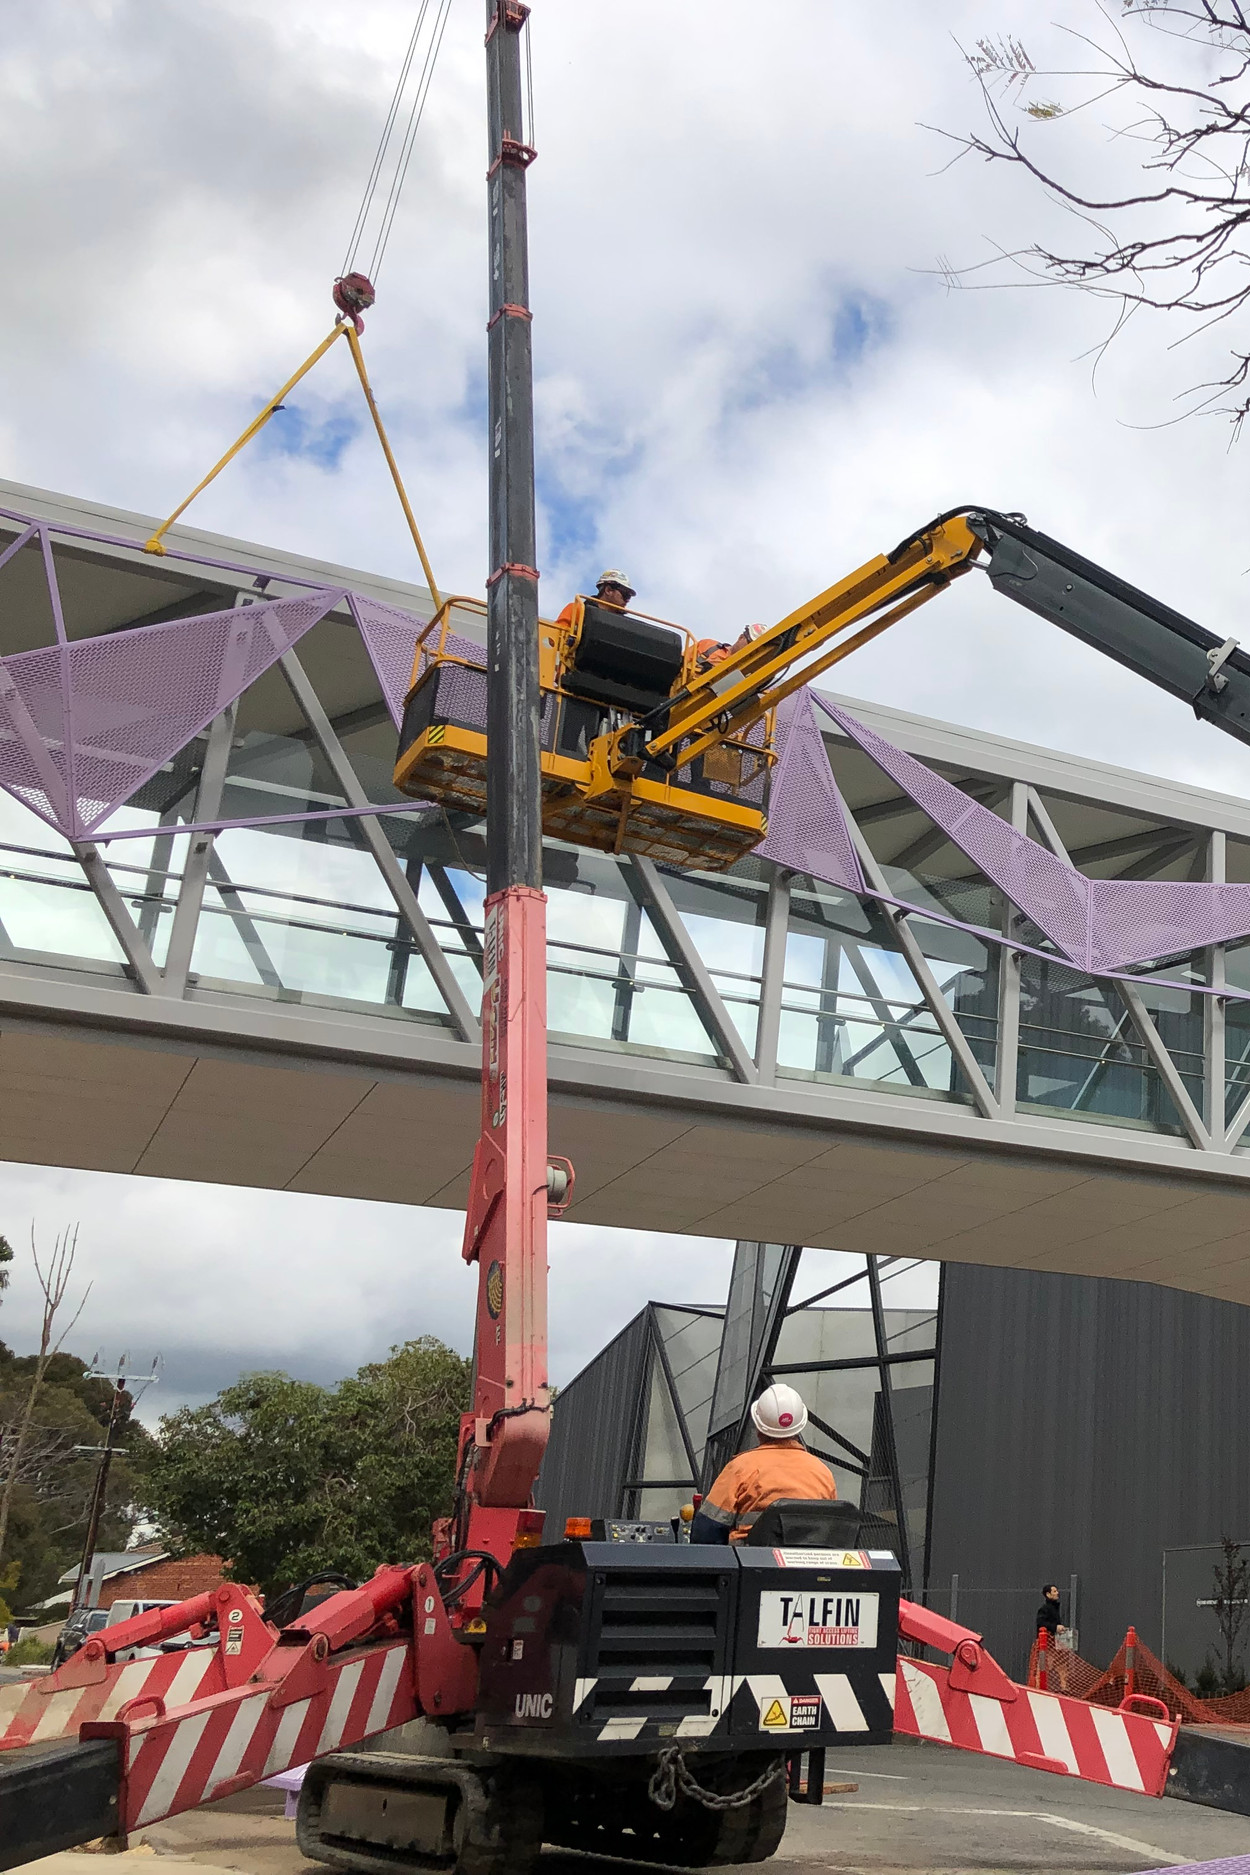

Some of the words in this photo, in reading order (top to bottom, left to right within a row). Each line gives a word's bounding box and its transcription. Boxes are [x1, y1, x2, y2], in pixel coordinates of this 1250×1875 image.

[231, 1611, 240, 1621] 2
[780, 1594, 860, 1628] TALFIN
[808, 1634, 858, 1645] SOLUTIONS
[515, 1693, 553, 1718] UNIC
[792, 1705, 817, 1716] EARTH
[791, 1716, 816, 1726] CHAIN
